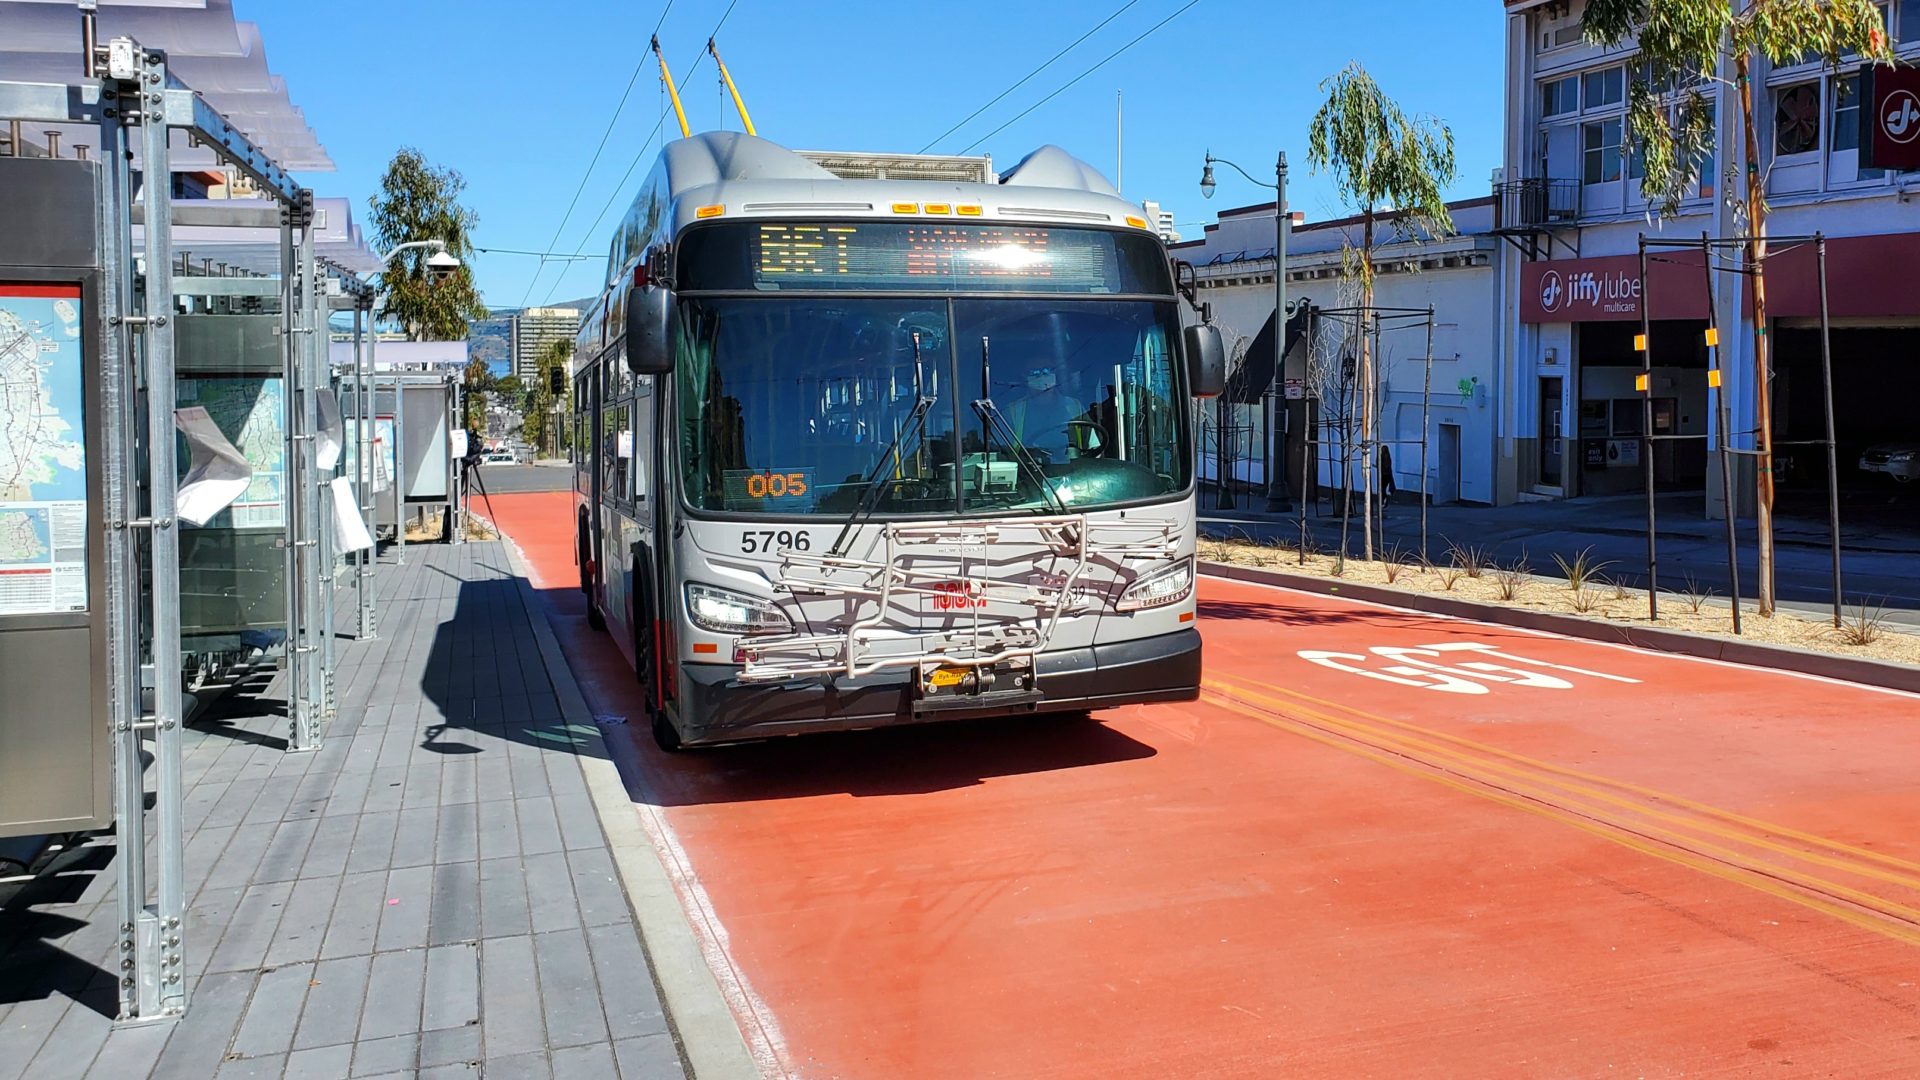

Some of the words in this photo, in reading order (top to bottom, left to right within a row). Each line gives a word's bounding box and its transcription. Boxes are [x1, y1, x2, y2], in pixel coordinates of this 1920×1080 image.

[760, 226, 857, 273] BRT
[1566, 272, 1602, 308] jiffy
[1604, 271, 1641, 299] lube
[1603, 302, 1636, 313] multicare
[747, 473, 807, 498] 005
[741, 530, 811, 554] 5796
